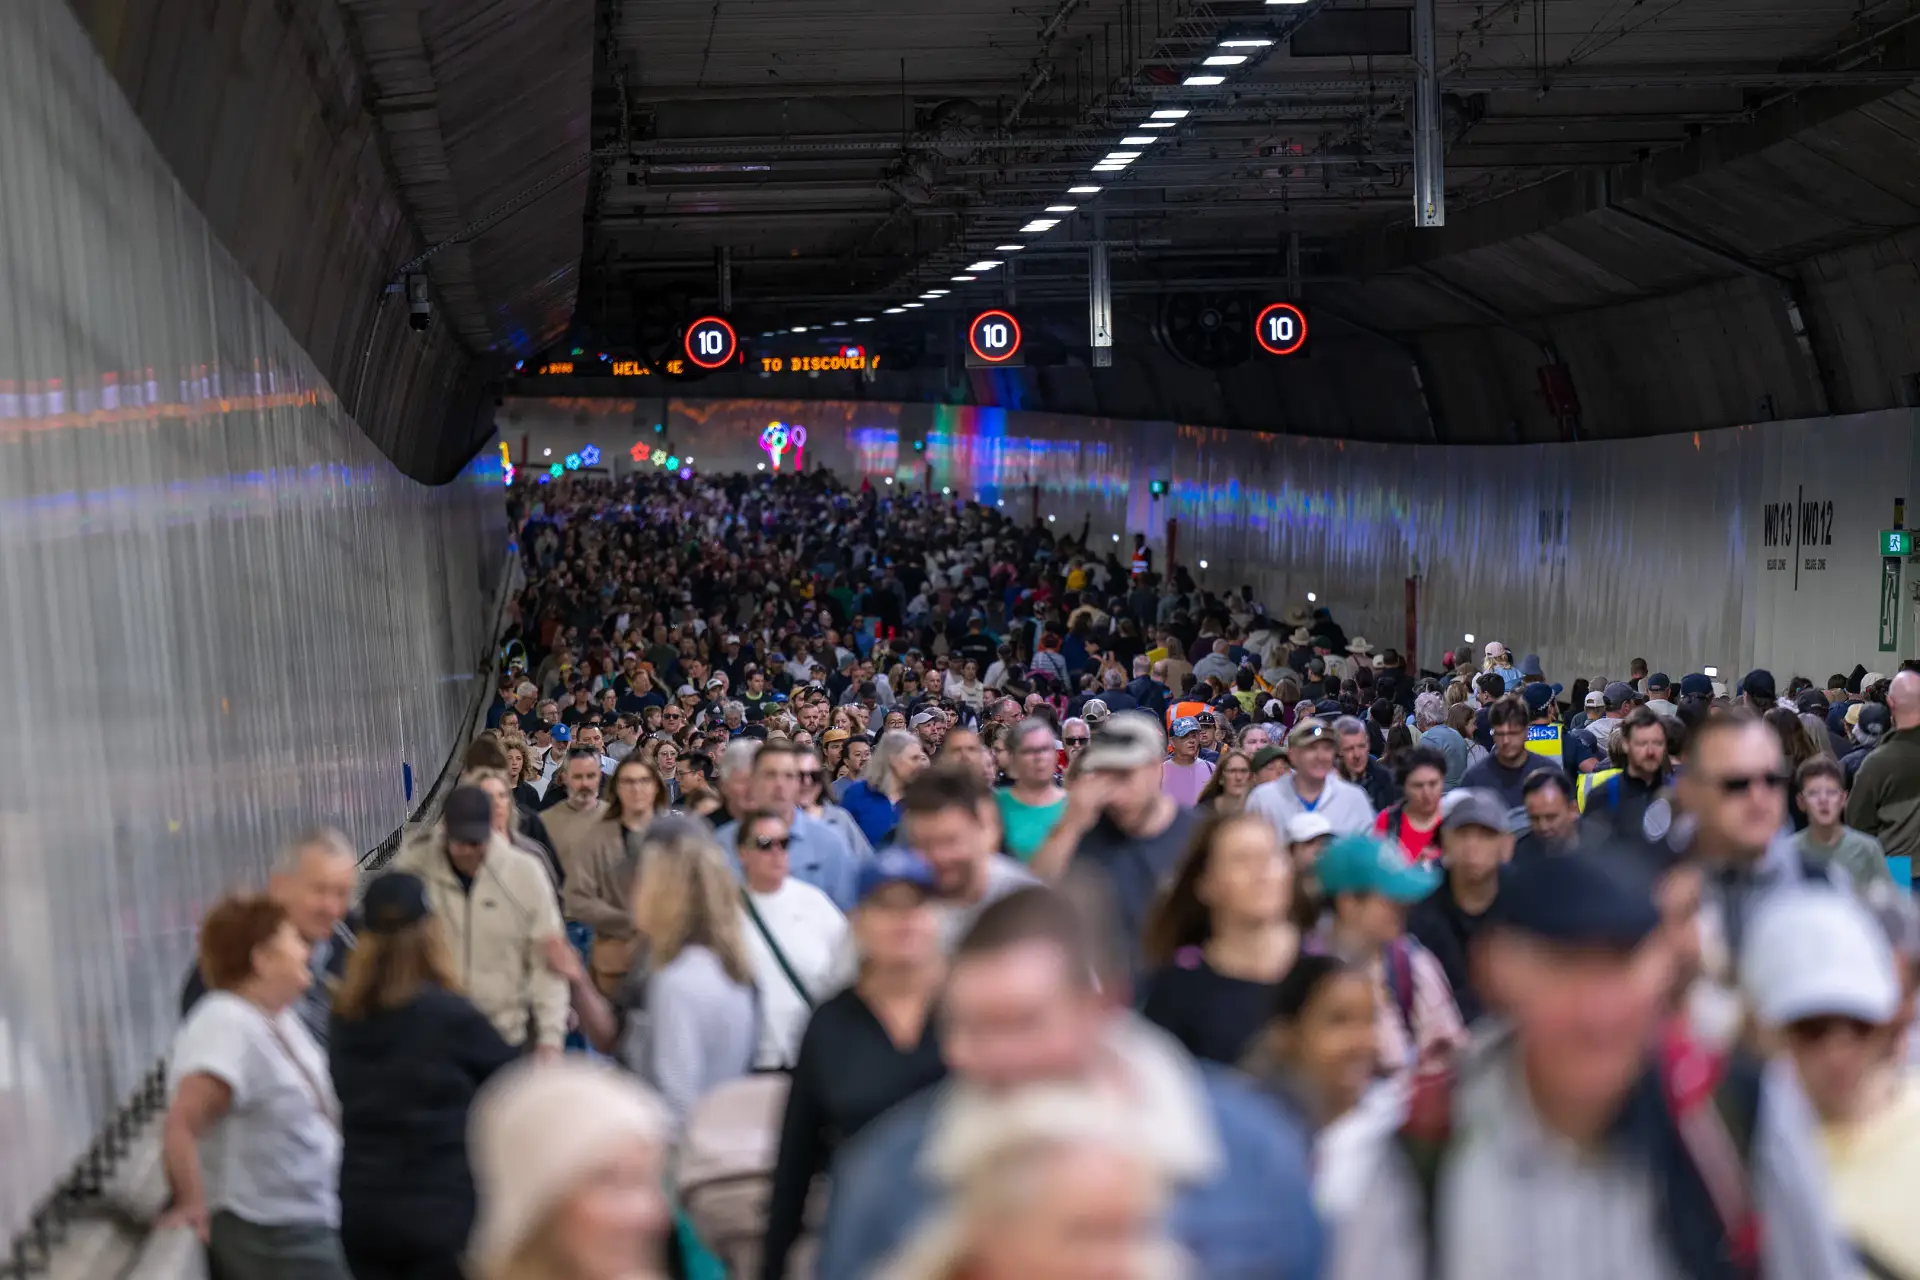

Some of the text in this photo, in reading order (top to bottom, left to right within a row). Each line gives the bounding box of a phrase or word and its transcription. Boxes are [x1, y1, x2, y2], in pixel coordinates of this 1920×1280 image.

[983, 324, 1007, 347] 10
[1269, 317, 1293, 340] 10
[698, 331, 722, 354] 10
[613, 355, 881, 375] WELE TO DISCOVEY
[1527, 728, 1556, 738] olice
